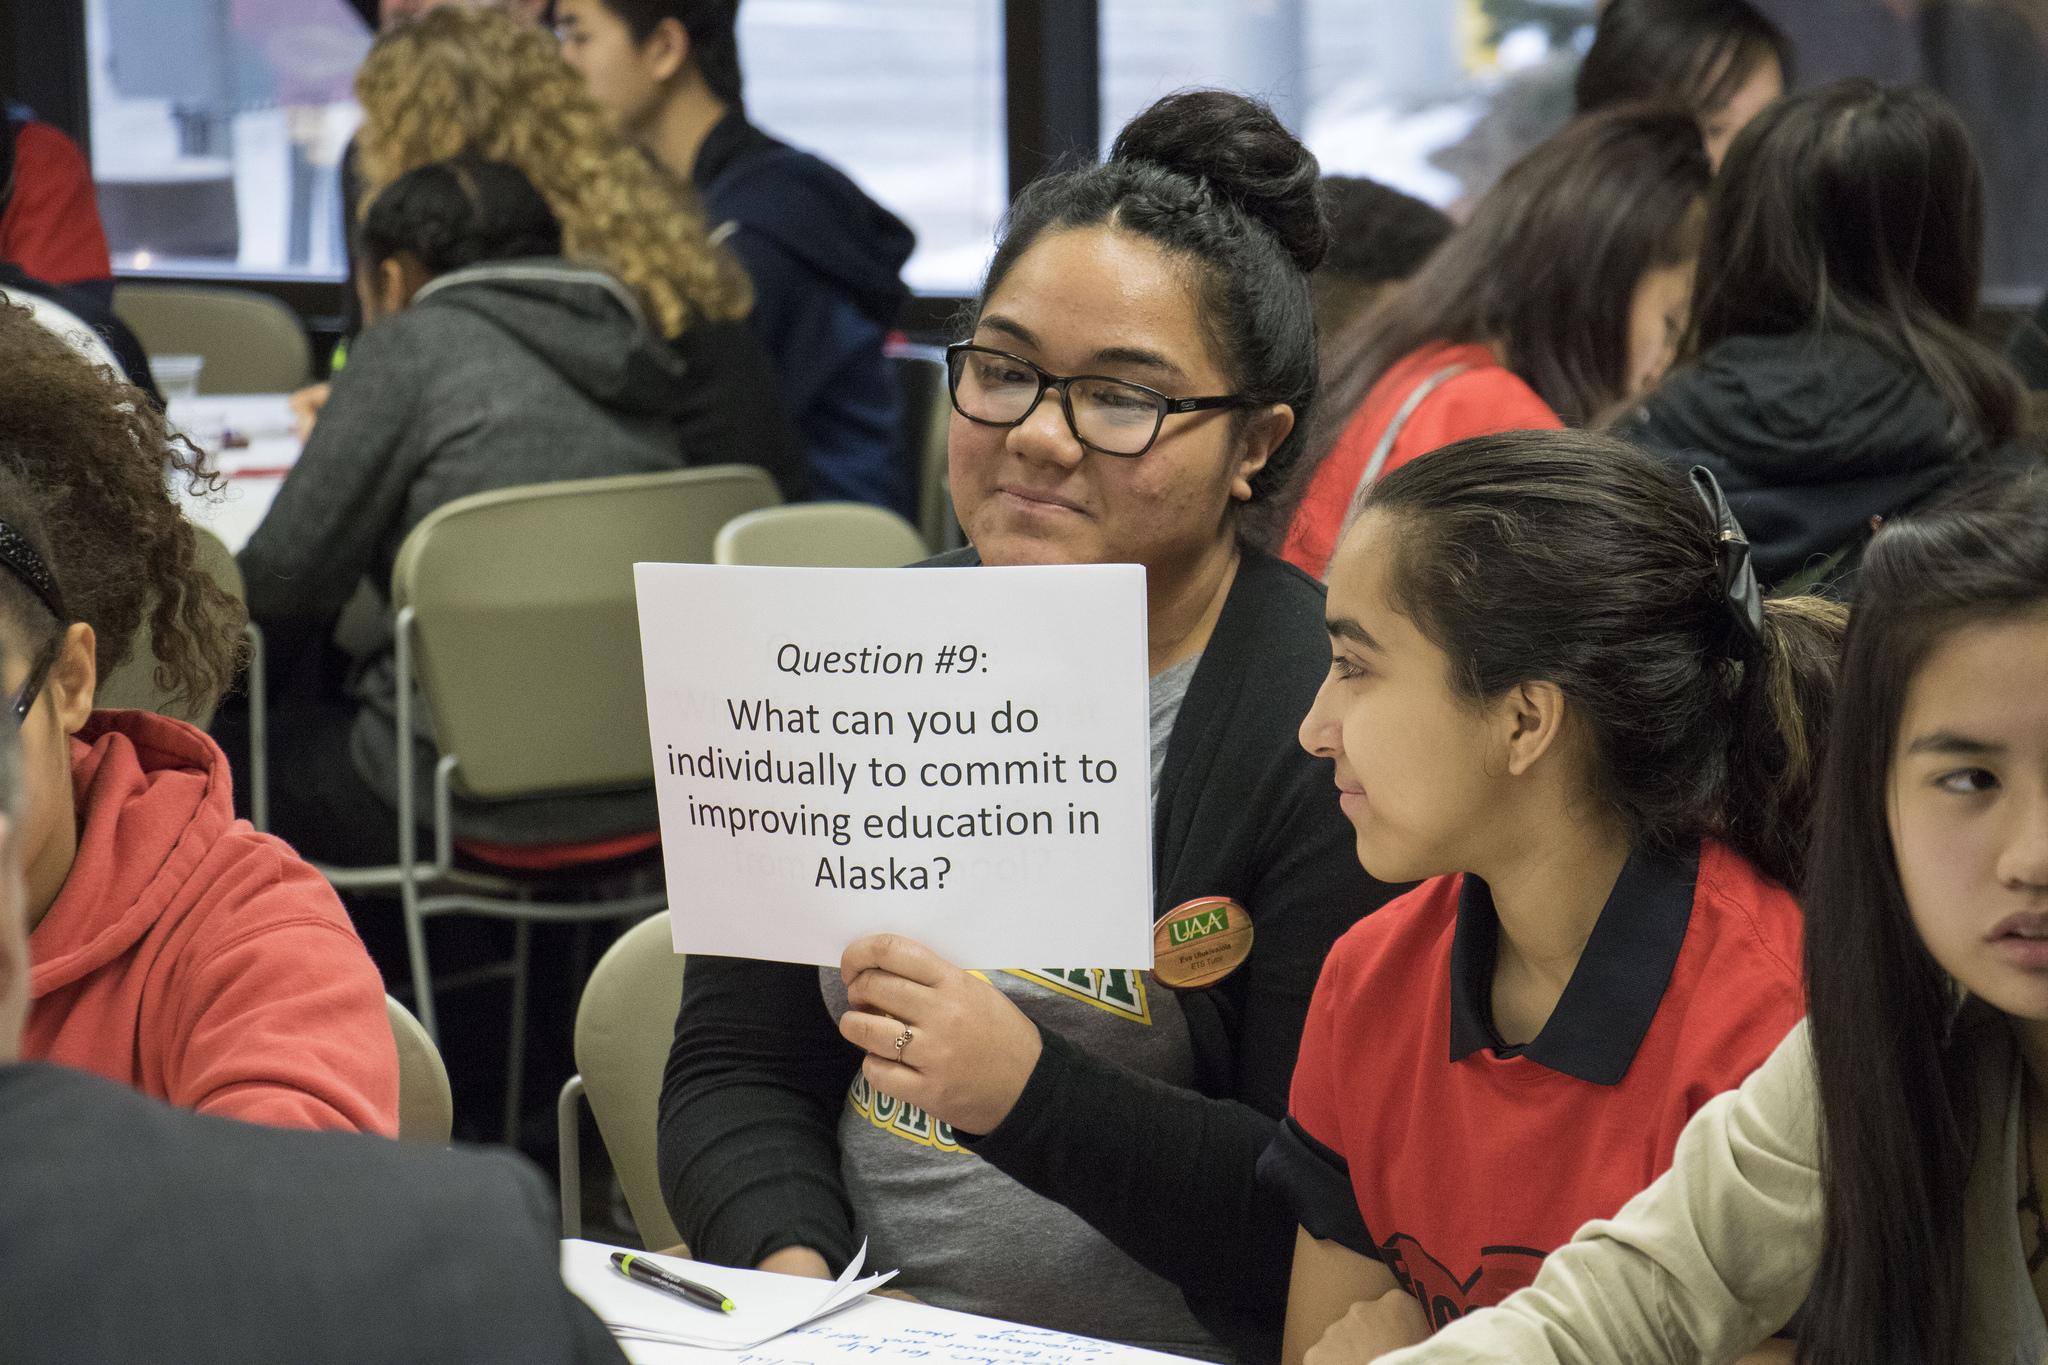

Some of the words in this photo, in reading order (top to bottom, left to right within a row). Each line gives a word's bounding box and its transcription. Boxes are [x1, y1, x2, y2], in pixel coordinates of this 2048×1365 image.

[778, 644, 922, 676] Question
[935, 645, 987, 673] #9:
[727, 699, 819, 733] What
[833, 711, 893, 735] can
[908, 711, 975, 743] you
[992, 701, 1038, 733] do
[668, 744, 856, 794] individually
[869, 758, 906, 787] to
[921, 752, 1066, 786] commit
[1079, 755, 1117, 783] to
[689, 795, 851, 845] improving
[864, 805, 1052, 838] education
[1069, 803, 1098, 834] in
[815, 856, 950, 890] Alaska?
[1173, 912, 1223, 942] UAA
